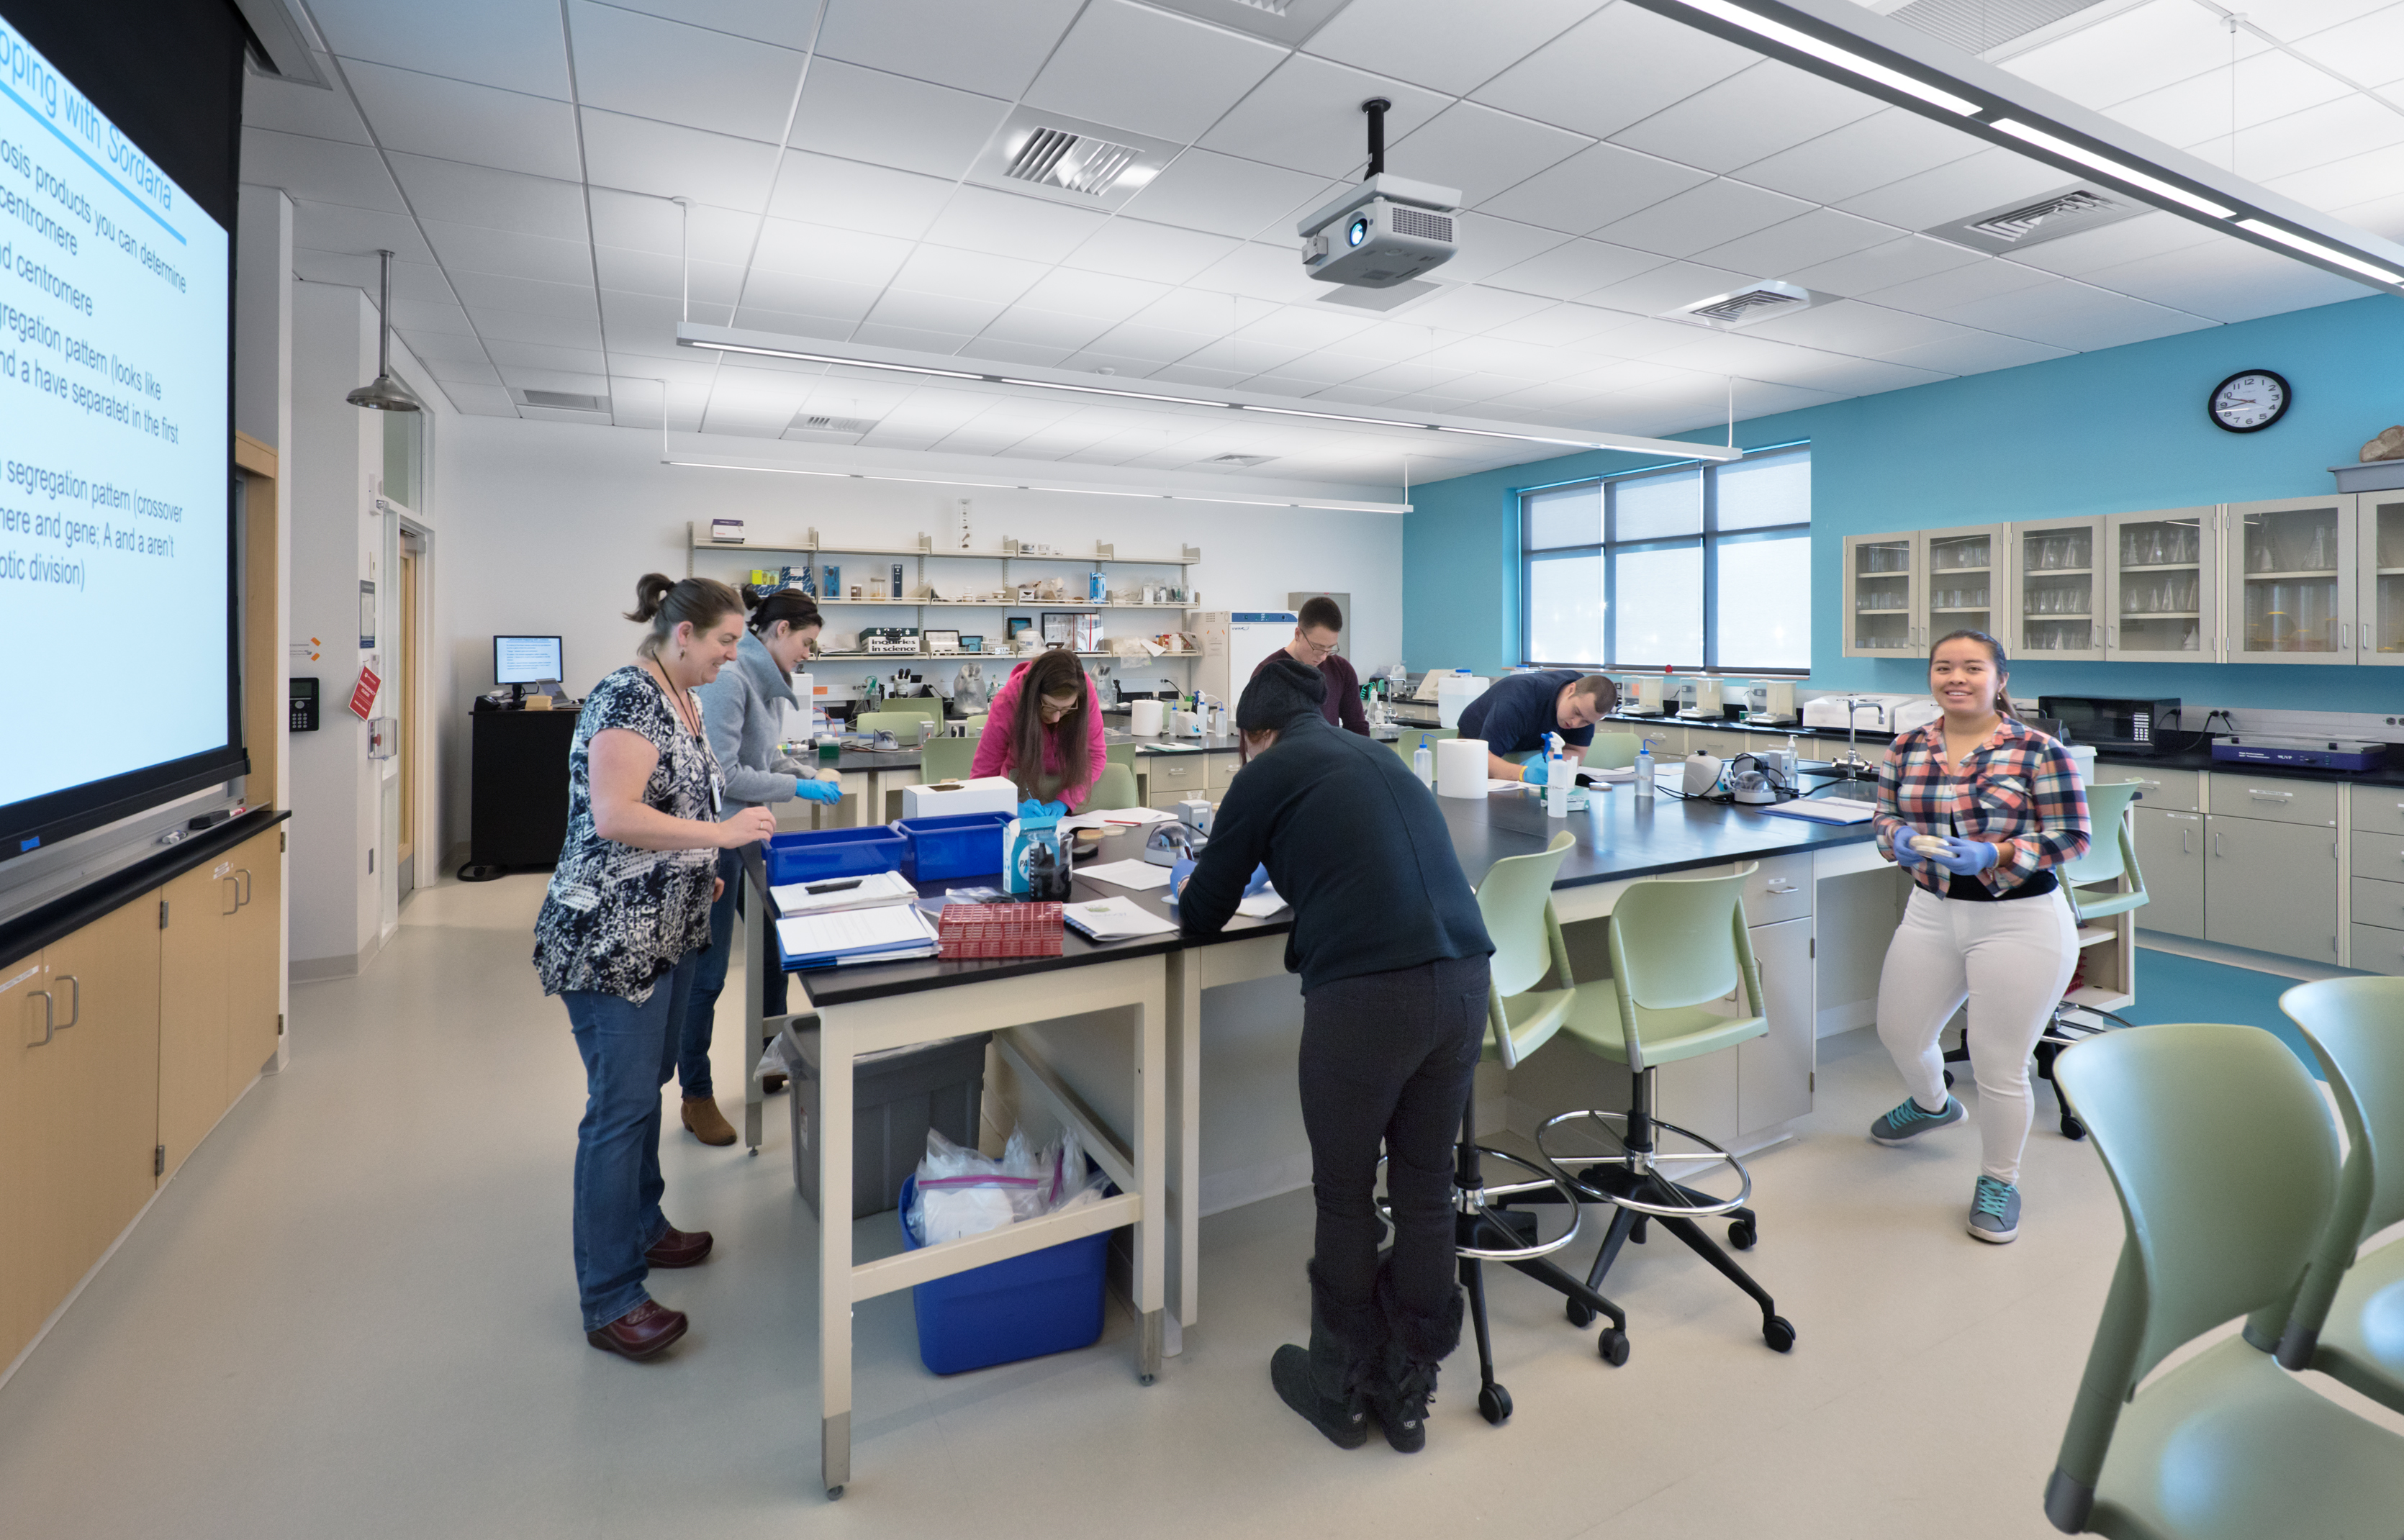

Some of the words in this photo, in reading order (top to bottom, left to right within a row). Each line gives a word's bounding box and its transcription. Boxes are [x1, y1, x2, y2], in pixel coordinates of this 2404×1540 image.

[64, 86, 101, 149] with
[107, 123, 171, 211] Sordaria
[36, 164, 92, 225] products
[95, 209, 115, 242] you
[119, 228, 137, 259] can
[140, 242, 186, 294] determine
[17, 254, 92, 317] centromere
[0, 302, 60, 352] regation
[66, 336, 107, 375] pattern
[112, 354, 142, 392] (looks
[145, 371, 161, 400] like
[22, 361, 30, 384] a
[35, 359, 68, 399] have
[72, 383, 129, 425] separated
[132, 403, 141, 430] in
[144, 409, 159, 436] the
[162, 417, 179, 445] first
[7, 460, 87, 500] segregation
[92, 481, 130, 509] pattern
[134, 489, 183, 523] (crossover
[36, 512, 60, 538] and
[65, 520, 99, 550] gene;
[104, 522, 112, 548] A
[115, 527, 135, 551] and
[138, 535, 145, 553] a
[148, 535, 174, 558] aren't
[30, 553, 85, 592] division)
